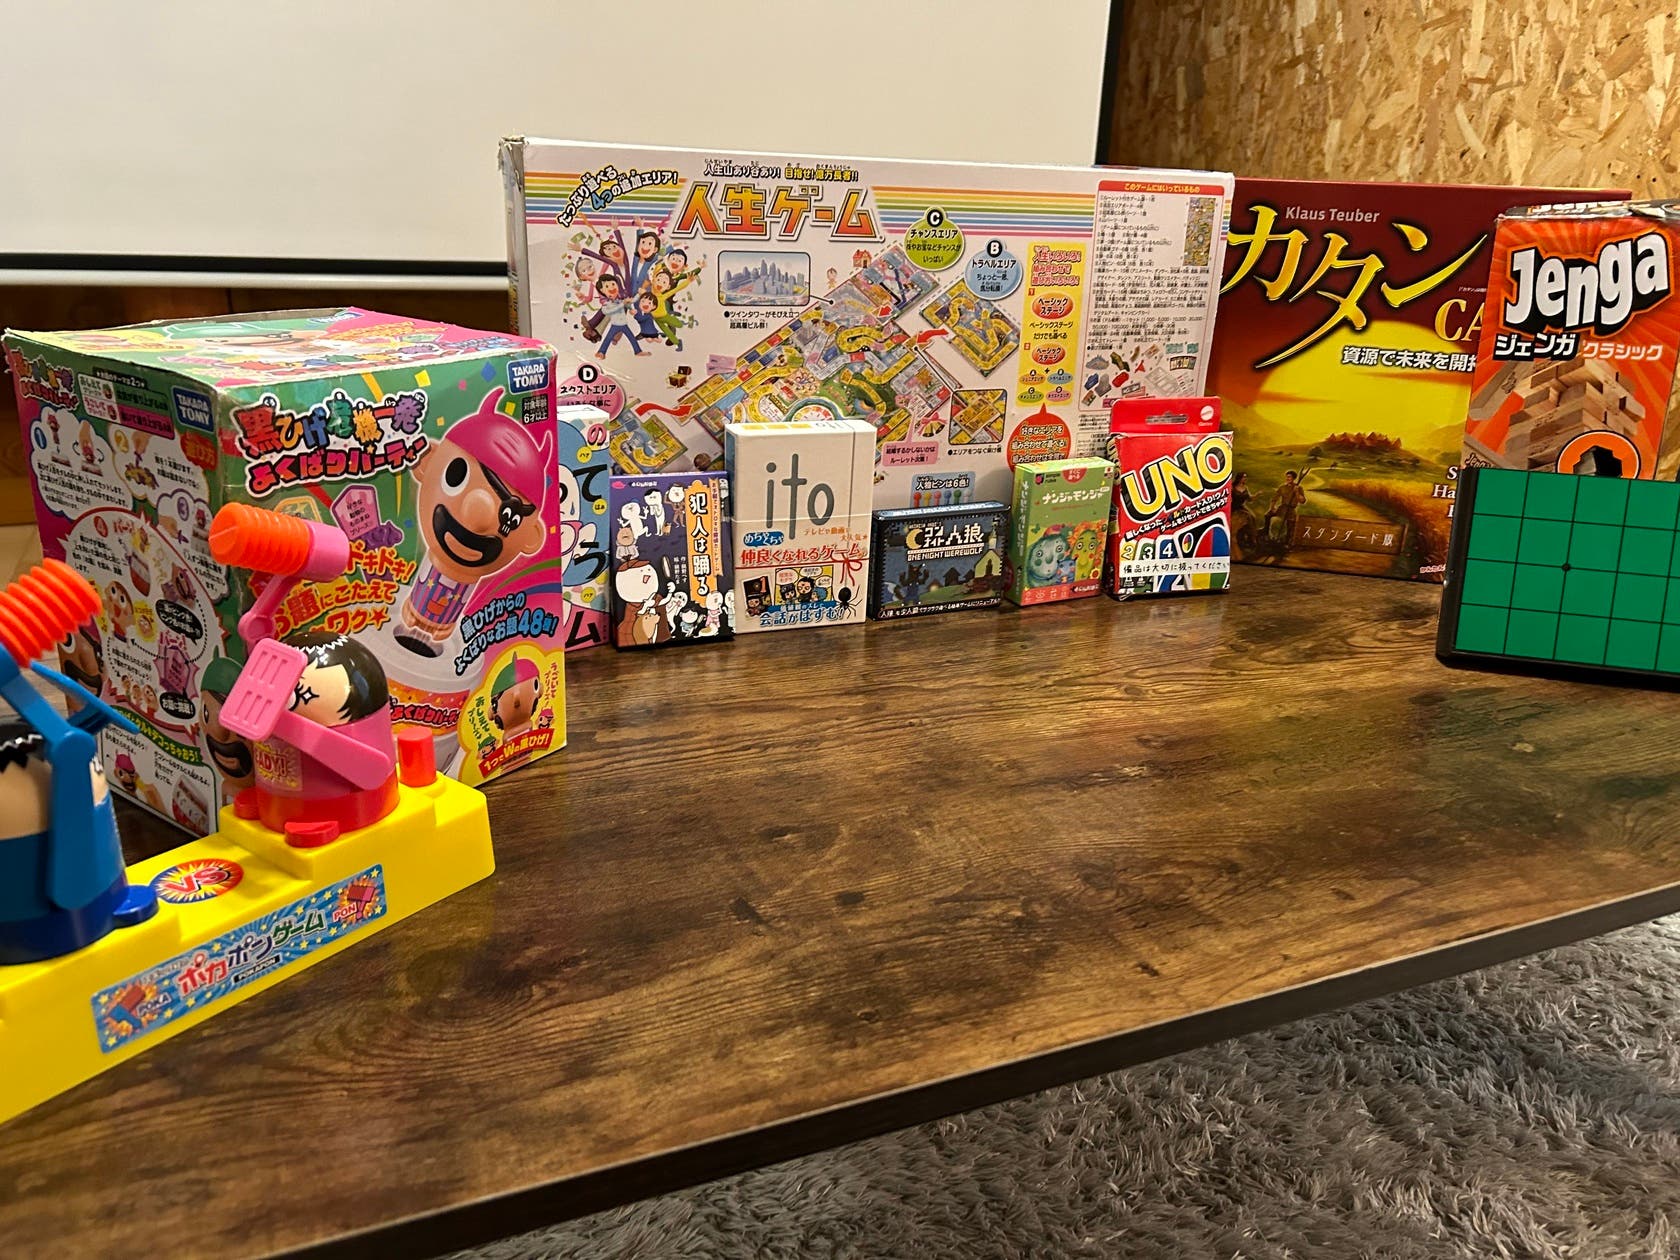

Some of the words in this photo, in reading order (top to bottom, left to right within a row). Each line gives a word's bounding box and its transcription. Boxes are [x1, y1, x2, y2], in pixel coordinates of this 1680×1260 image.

[673, 181, 880, 239] 人生ゲーム
[929, 211, 941, 226] C
[1286, 206, 1326, 221] Klaus
[1329, 208, 1380, 223] Teuber
[910, 229, 959, 239] チャンスエリア
[990, 241, 1001, 255] B
[972, 260, 1017, 269] トラベルエリア
[1221, 205, 1488, 369] カタン
[1503, 232, 1671, 330] Jenga
[1038, 297, 1069, 306] ベーシック
[1040, 306, 1065, 315] ステージ
[1036, 347, 1062, 355] ベーシック
[1494, 332, 1579, 358] ジェンガ
[1582, 341, 1664, 362] クラシック
[1039, 354, 1060, 362] ステージ
[512, 362, 546, 378] TAKARA
[582, 364, 598, 382] D
[512, 373, 546, 389] TOMY
[560, 384, 617, 395] ネクストエリア
[175, 392, 209, 411] TAKARA
[179, 404, 210, 427] TOMY
[237, 394, 426, 458] 黒ひげ危機一発
[523, 411, 548, 424] 6才以上
[249, 436, 429, 496] よくばりパーティー
[1120, 436, 1233, 522] UNO
[766, 453, 835, 540] ito
[1042, 487, 1104, 505] ナンジャモンジャ
[689, 492, 711, 597] 犯人は踊る
[945, 523, 985, 546] 人狼
[1302, 525, 1395, 548] スタンダード版
[740, 543, 862, 565] 仲良くなれるゲーム
[907, 553, 921, 562] ONE
[922, 551, 944, 560] NIGHT
[945, 548, 983, 558] WEREWOLF
[1121, 544, 1135, 560] 2
[1142, 546, 1154, 560] 3
[1162, 542, 1174, 558] 4
[461, 591, 526, 642] 黒ひげからの
[564, 611, 602, 649] ム
[163, 865, 228, 893] VS
[332, 901, 359, 923] PON
[176, 908, 325, 996] ポカポンゲーム
[237, 957, 278, 980] POKAPON
